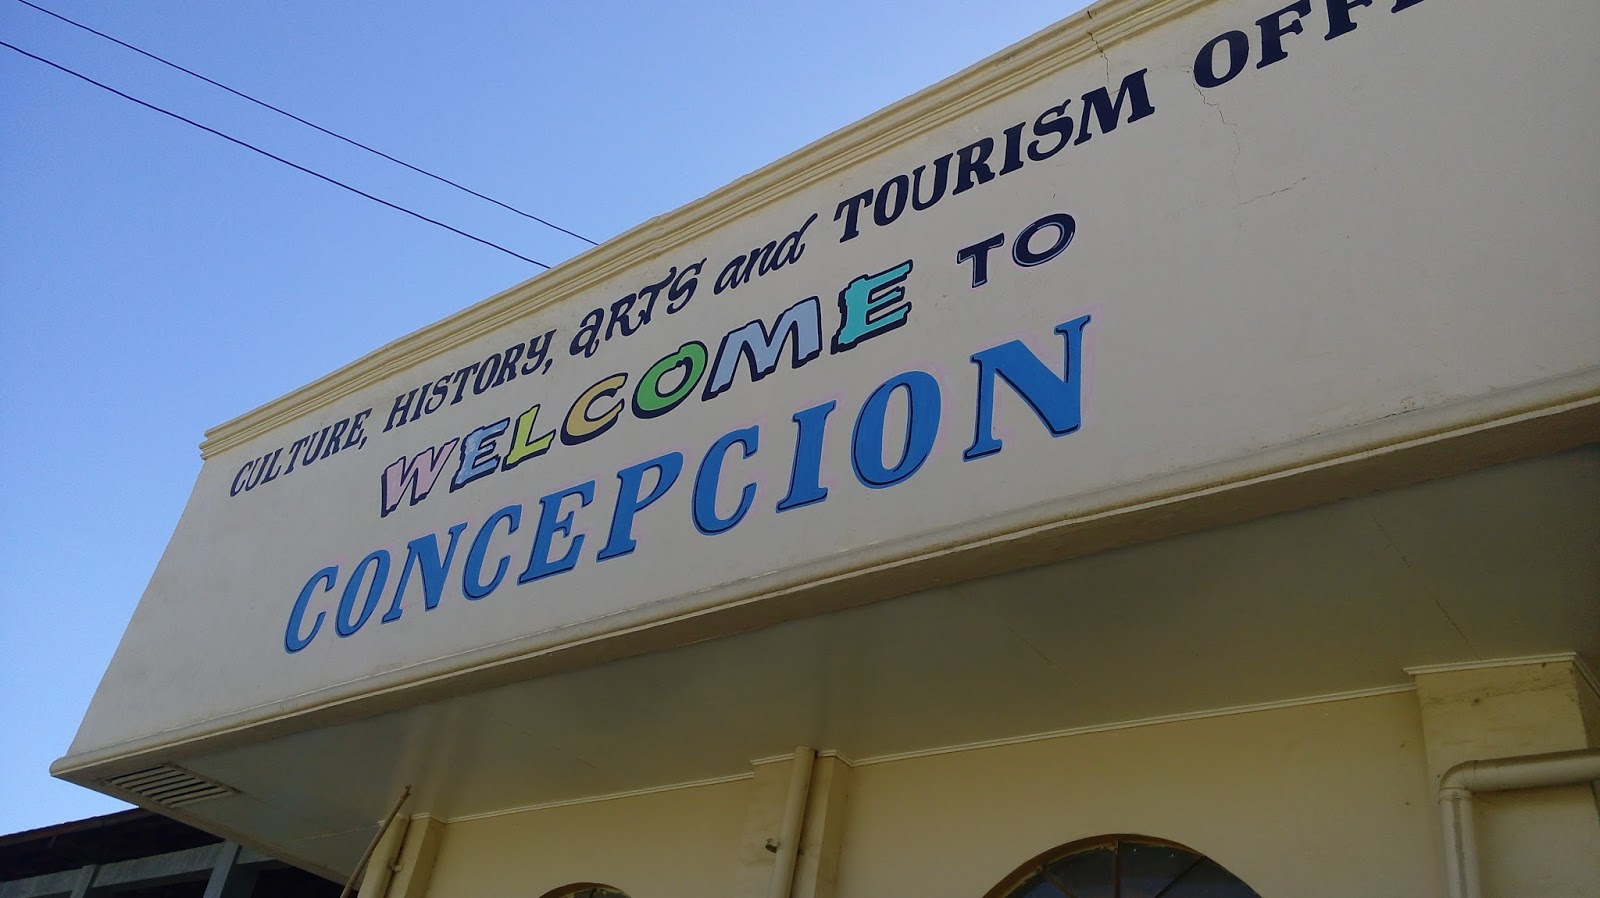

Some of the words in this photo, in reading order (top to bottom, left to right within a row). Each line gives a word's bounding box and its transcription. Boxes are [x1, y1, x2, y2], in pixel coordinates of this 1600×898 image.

[230, 408, 373, 498] CULTURE,
[382, 329, 557, 433] HISTORY,
[713, 212, 818, 295] and
[833, 68, 1155, 243] TOURISM
[1193, 0, 1424, 88] OFF
[380, 259, 913, 518] WELCOME
[956, 212, 1077, 288] TO
[283, 314, 1093, 655] CONCEPCION
